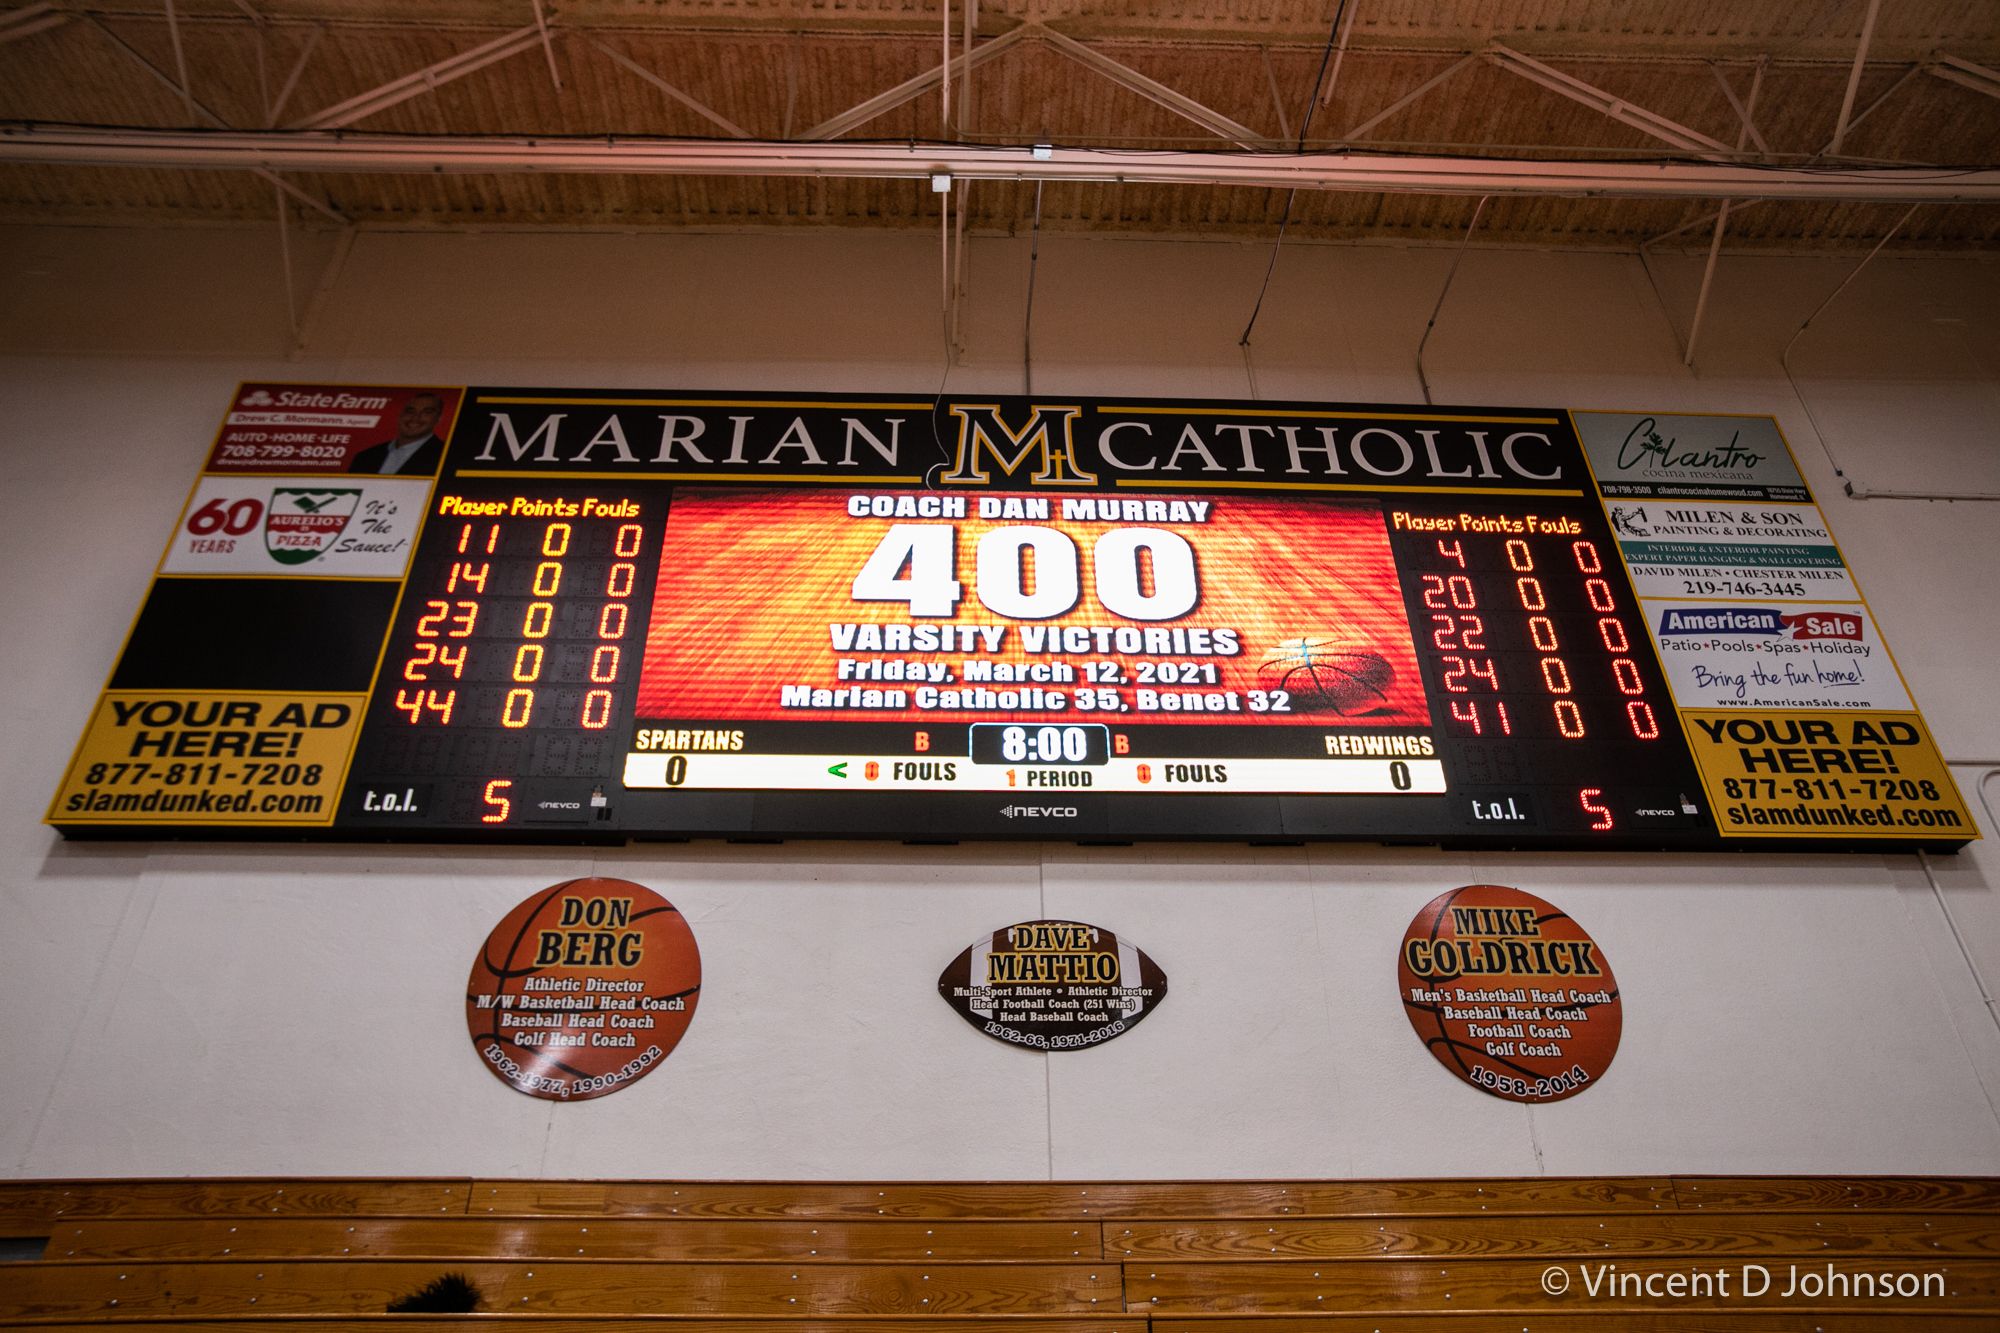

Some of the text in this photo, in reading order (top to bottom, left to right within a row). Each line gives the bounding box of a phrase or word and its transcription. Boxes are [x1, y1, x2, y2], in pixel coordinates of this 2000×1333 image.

[235, 414, 267, 423] Drew
[474, 412, 906, 467] MARIAN
[1099, 421, 1562, 481] CATHOLIC
[1617, 417, 1766, 470] Cilantro
[217, 458, 341, 467] drew@drewmormann.com
[221, 446, 345, 459] 708-799-8020
[1642, 468, 1754, 481] cocina mexicana
[187, 498, 264, 536] 60
[365, 500, 398, 515] It's
[439, 496, 640, 518] Player Points Fouls
[848, 495, 1210, 522] COACH DAN MURRAY
[1664, 510, 1804, 526] MILEN & SON
[270, 516, 345, 528] AURELIO'S
[361, 519, 392, 534] The
[1392, 511, 1582, 535] Player Points Fouls
[1653, 525, 1828, 539] PAINTING & DECORATING
[189, 539, 237, 554] YEARS
[276, 536, 322, 547] PIZZA
[334, 539, 407, 553] Sauce!
[458, 524, 500, 554] 11
[1647, 544, 1810, 556] INTERIOR EXTERIOR PAINTING
[1438, 539, 1466, 568] 4
[1625, 553, 1841, 566] EXPERT PAPER HANGING WALLCOVERING
[447, 563, 489, 593] 14
[852, 524, 1197, 621] 400
[1633, 566, 1845, 580] DAVID MILEN CHESTER MILEN
[1422, 575, 1477, 609] 20
[1682, 580, 1806, 597] 219-746-3445
[417, 601, 479, 637] 23
[1668, 610, 1857, 636] American Sale
[830, 624, 1240, 655] VARSITY VICTORIES
[1432, 614, 1485, 650] 22
[1661, 638, 1871, 658] Patio Pools Spas Holiday
[404, 643, 467, 681] 24
[838, 659, 1216, 684] Friday, March 12, 2021
[1442, 655, 1499, 692] 24
[1691, 658, 1865, 699] Bring the fun home!
[396, 690, 456, 725] 44
[781, 685, 1291, 712] Marian Catholic 35, Benet 32
[1717, 698, 1872, 708] www.AmericanSale.com
[112, 701, 351, 728] YOUR AD
[1451, 701, 1511, 735] 41
[636, 729, 744, 751] SPARTANS
[1002, 726, 1088, 762] 8:00
[1693, 719, 1921, 746] YOUR AD
[129, 731, 303, 758] HERE!
[1325, 735, 1434, 756] REDWINGS
[893, 762, 957, 781] FOULS
[1739, 748, 1900, 774] HERE!
[85, 763, 323, 786] 877-811-7208
[1006, 769, 1093, 787] 1 PERIOD
[1164, 764, 1227, 783] FOULS
[66, 789, 324, 813] slamdunked.com
[364, 789, 417, 811] t.o.l.
[1722, 778, 1941, 801] 877-811-7208
[1472, 797, 1525, 820] t.o.l.
[1727, 803, 1962, 827] slamdunked.com
[559, 897, 632, 928] DON
[1451, 907, 1540, 937] MIKE
[534, 931, 643, 968] BERG
[1016, 927, 1089, 950] DAVE
[988, 953, 1118, 982] MATTIO
[1407, 940, 1602, 976] GOLDRICK
[523, 977, 645, 993] Athletic Director
[953, 986, 1153, 998] Multi-Sport Athlete Athletic Director
[1411, 988, 1612, 1004] Men's Basketball Head Coach
[476, 995, 686, 1011] M/W Basketball Head Coach
[972, 999, 1136, 1010] Head Football Coach (251 Wins)
[1443, 1006, 1588, 1021] Baseball Head Coach
[501, 1013, 655, 1029] Baseball Head Coach
[1000, 1012, 1109, 1022] Head Baseball Coach
[514, 1031, 636, 1047] Golf Head Coach
[985, 1021, 1126, 1049] 1962-66, 1971-2016
[1468, 1023, 1572, 1039] Football Coach
[1486, 1042, 1562, 1057] Golf Coach
[484, 1044, 662, 1096] 1962-1977, 1990-1992
[1470, 1064, 1590, 1097] 1958-2014
